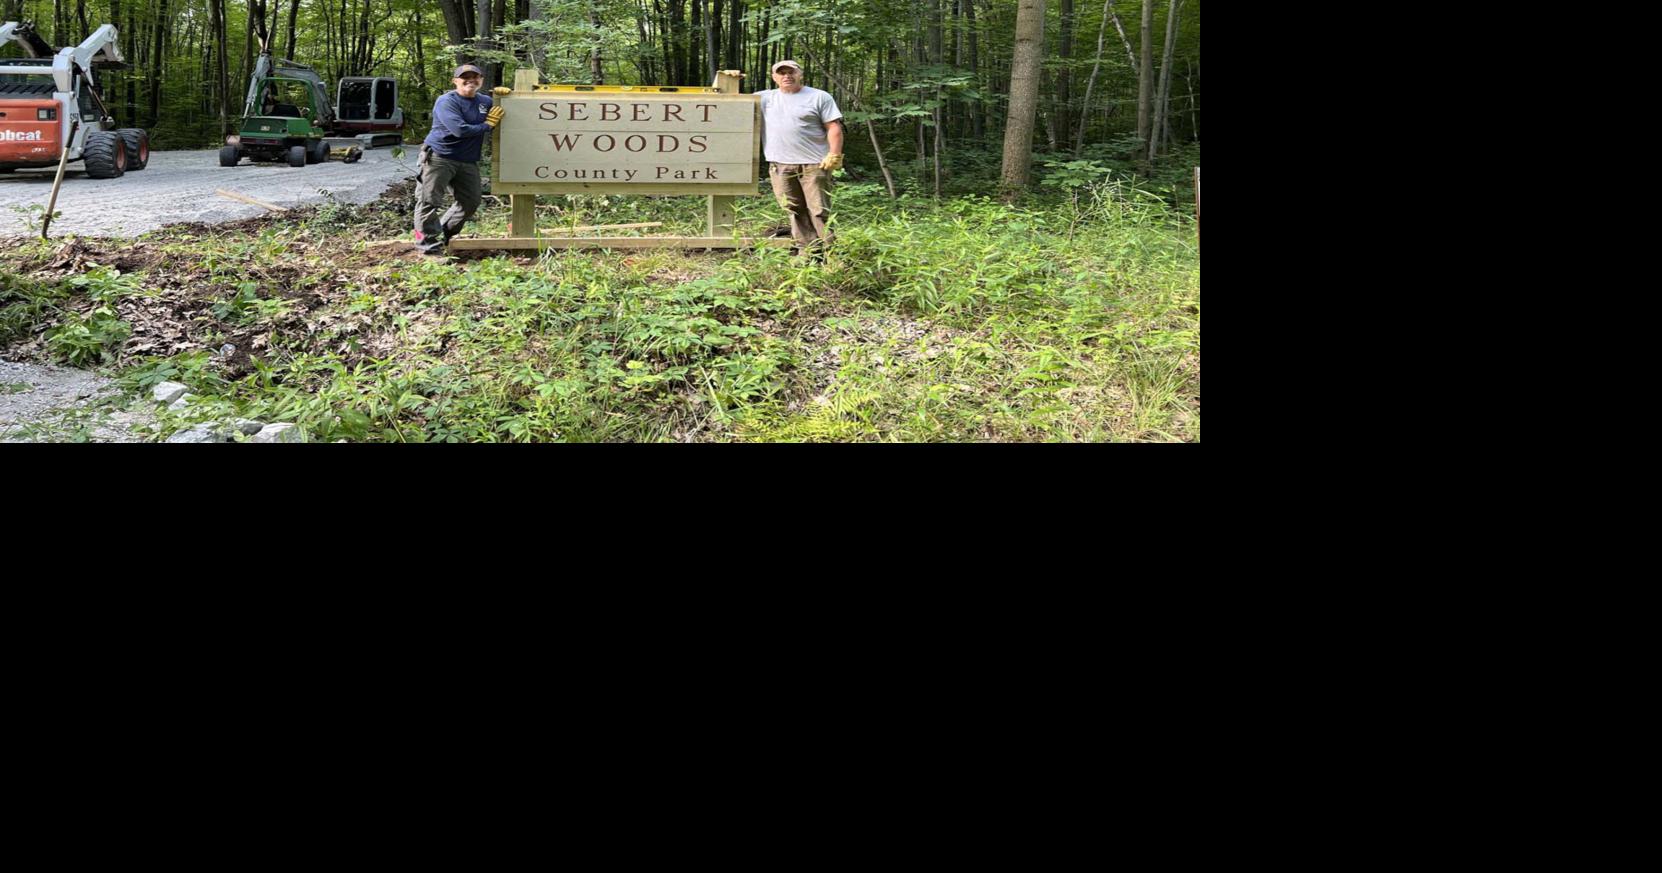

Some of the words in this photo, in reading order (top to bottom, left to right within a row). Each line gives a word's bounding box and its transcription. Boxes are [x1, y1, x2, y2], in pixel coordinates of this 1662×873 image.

[538, 103, 718, 122] SEBERT
[549, 134, 708, 153] WOODS
[534, 166, 639, 182] County
[656, 166, 719, 180] Park
